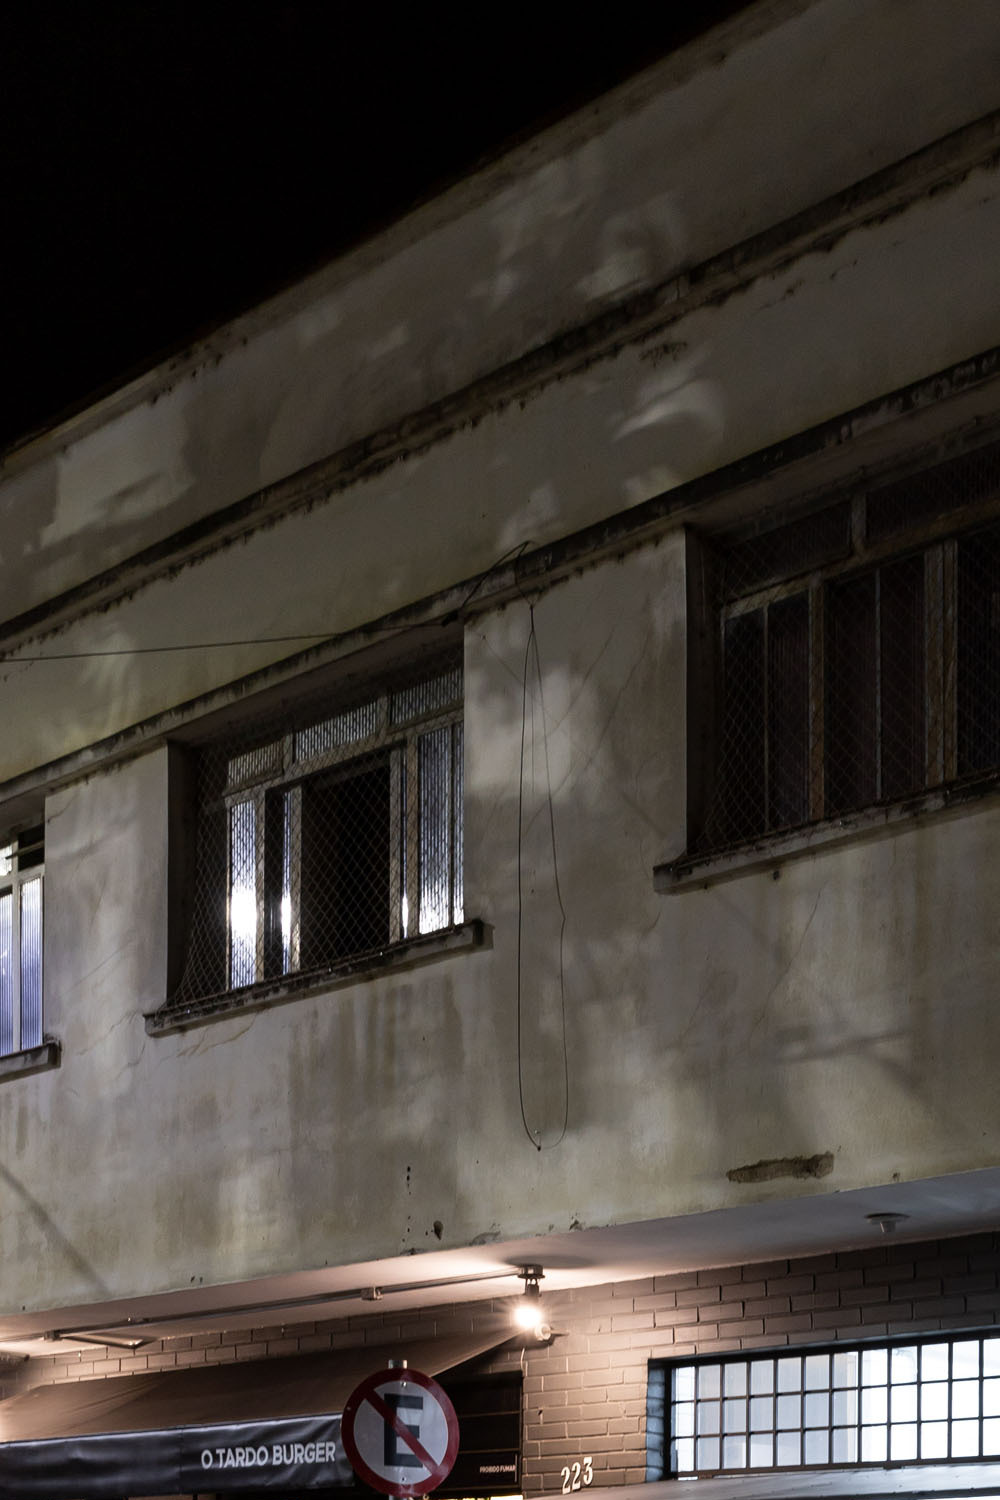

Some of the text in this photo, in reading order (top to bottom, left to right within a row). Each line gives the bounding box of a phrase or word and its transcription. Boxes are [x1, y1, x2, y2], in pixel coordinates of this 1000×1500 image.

[384, 1393, 423, 1468] E
[201, 1441, 336, 1469] O TARDO BURGER
[561, 1456, 594, 1494] 223
